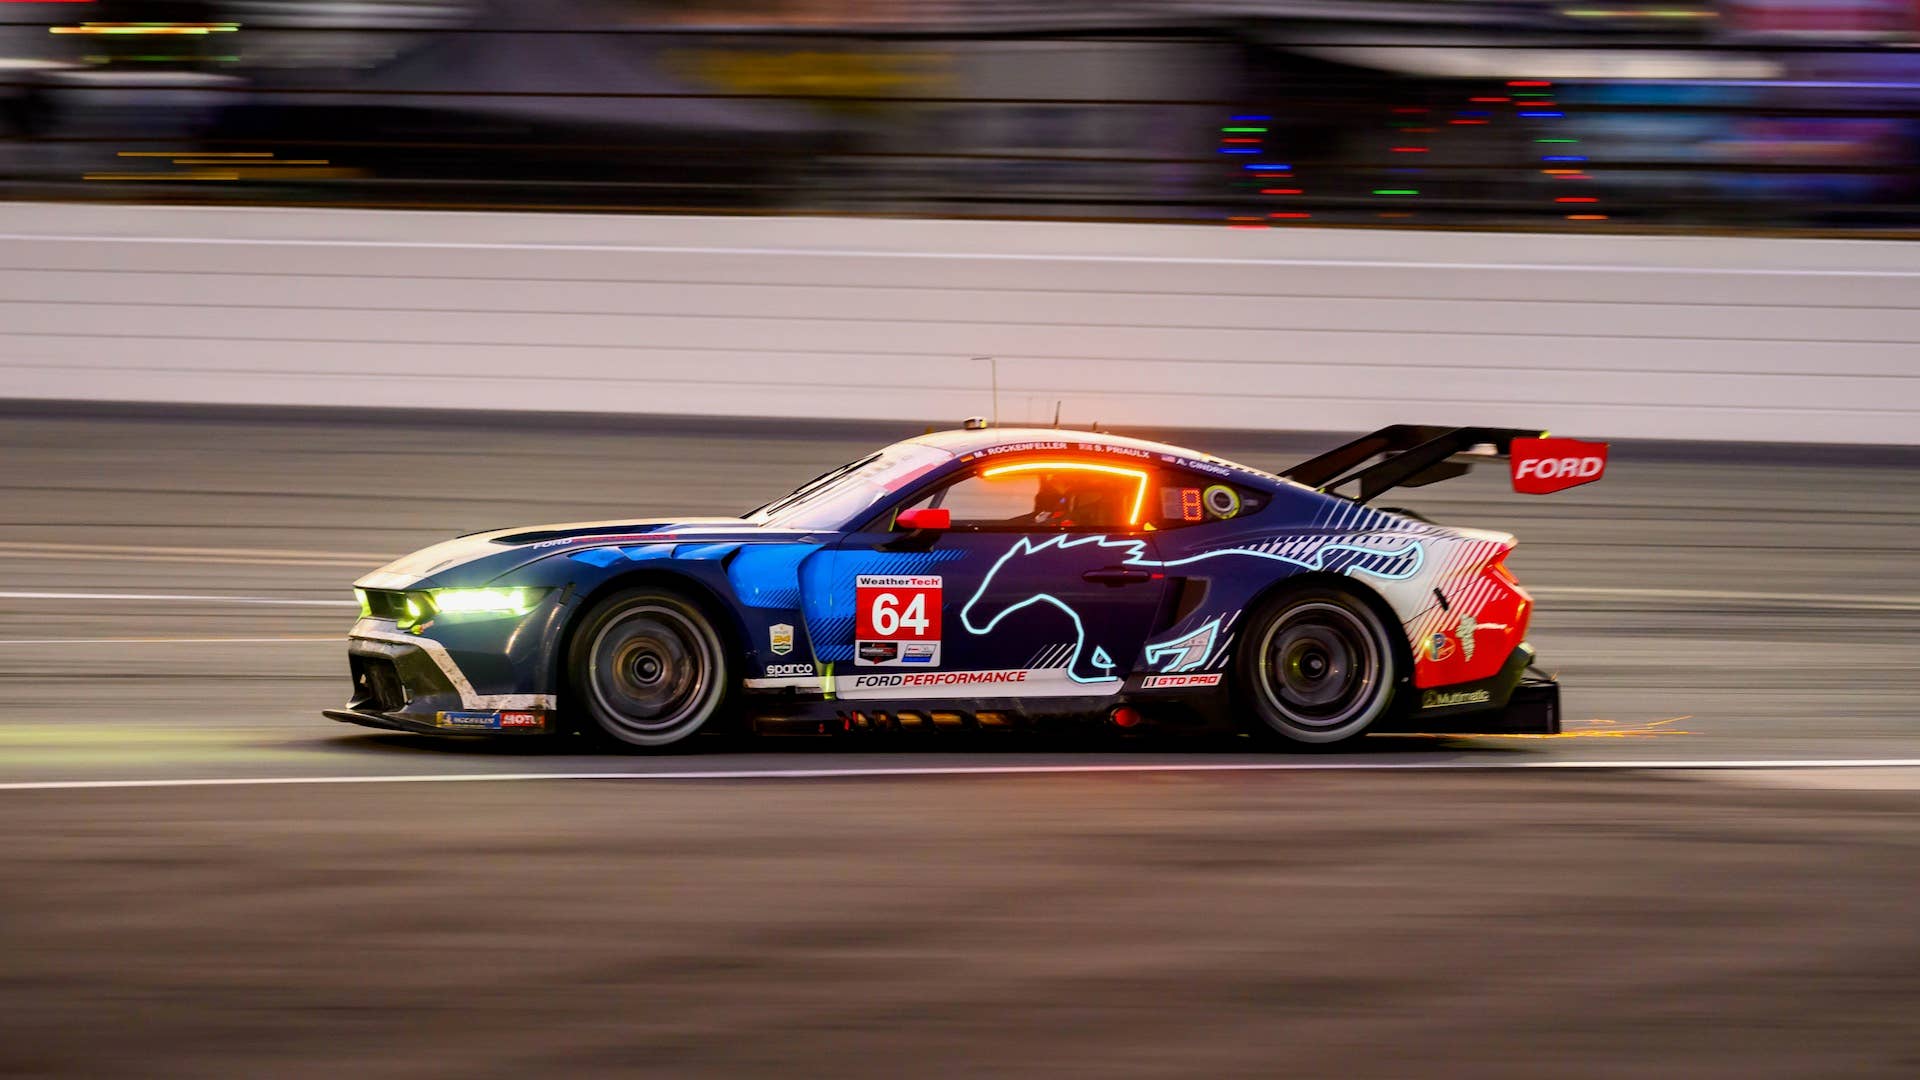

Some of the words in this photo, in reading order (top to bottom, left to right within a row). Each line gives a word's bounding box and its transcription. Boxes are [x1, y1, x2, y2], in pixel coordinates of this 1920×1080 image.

[974, 450, 987, 458] M.
[987, 443, 1068, 455] ROCKENFELLER
[1515, 457, 1604, 480] FORD
[860, 577, 938, 586] WeatherTech
[872, 593, 929, 636] 64
[766, 663, 813, 678] sparco
[1158, 677, 1187, 686] GTD
[1189, 676, 1218, 684] PRO
